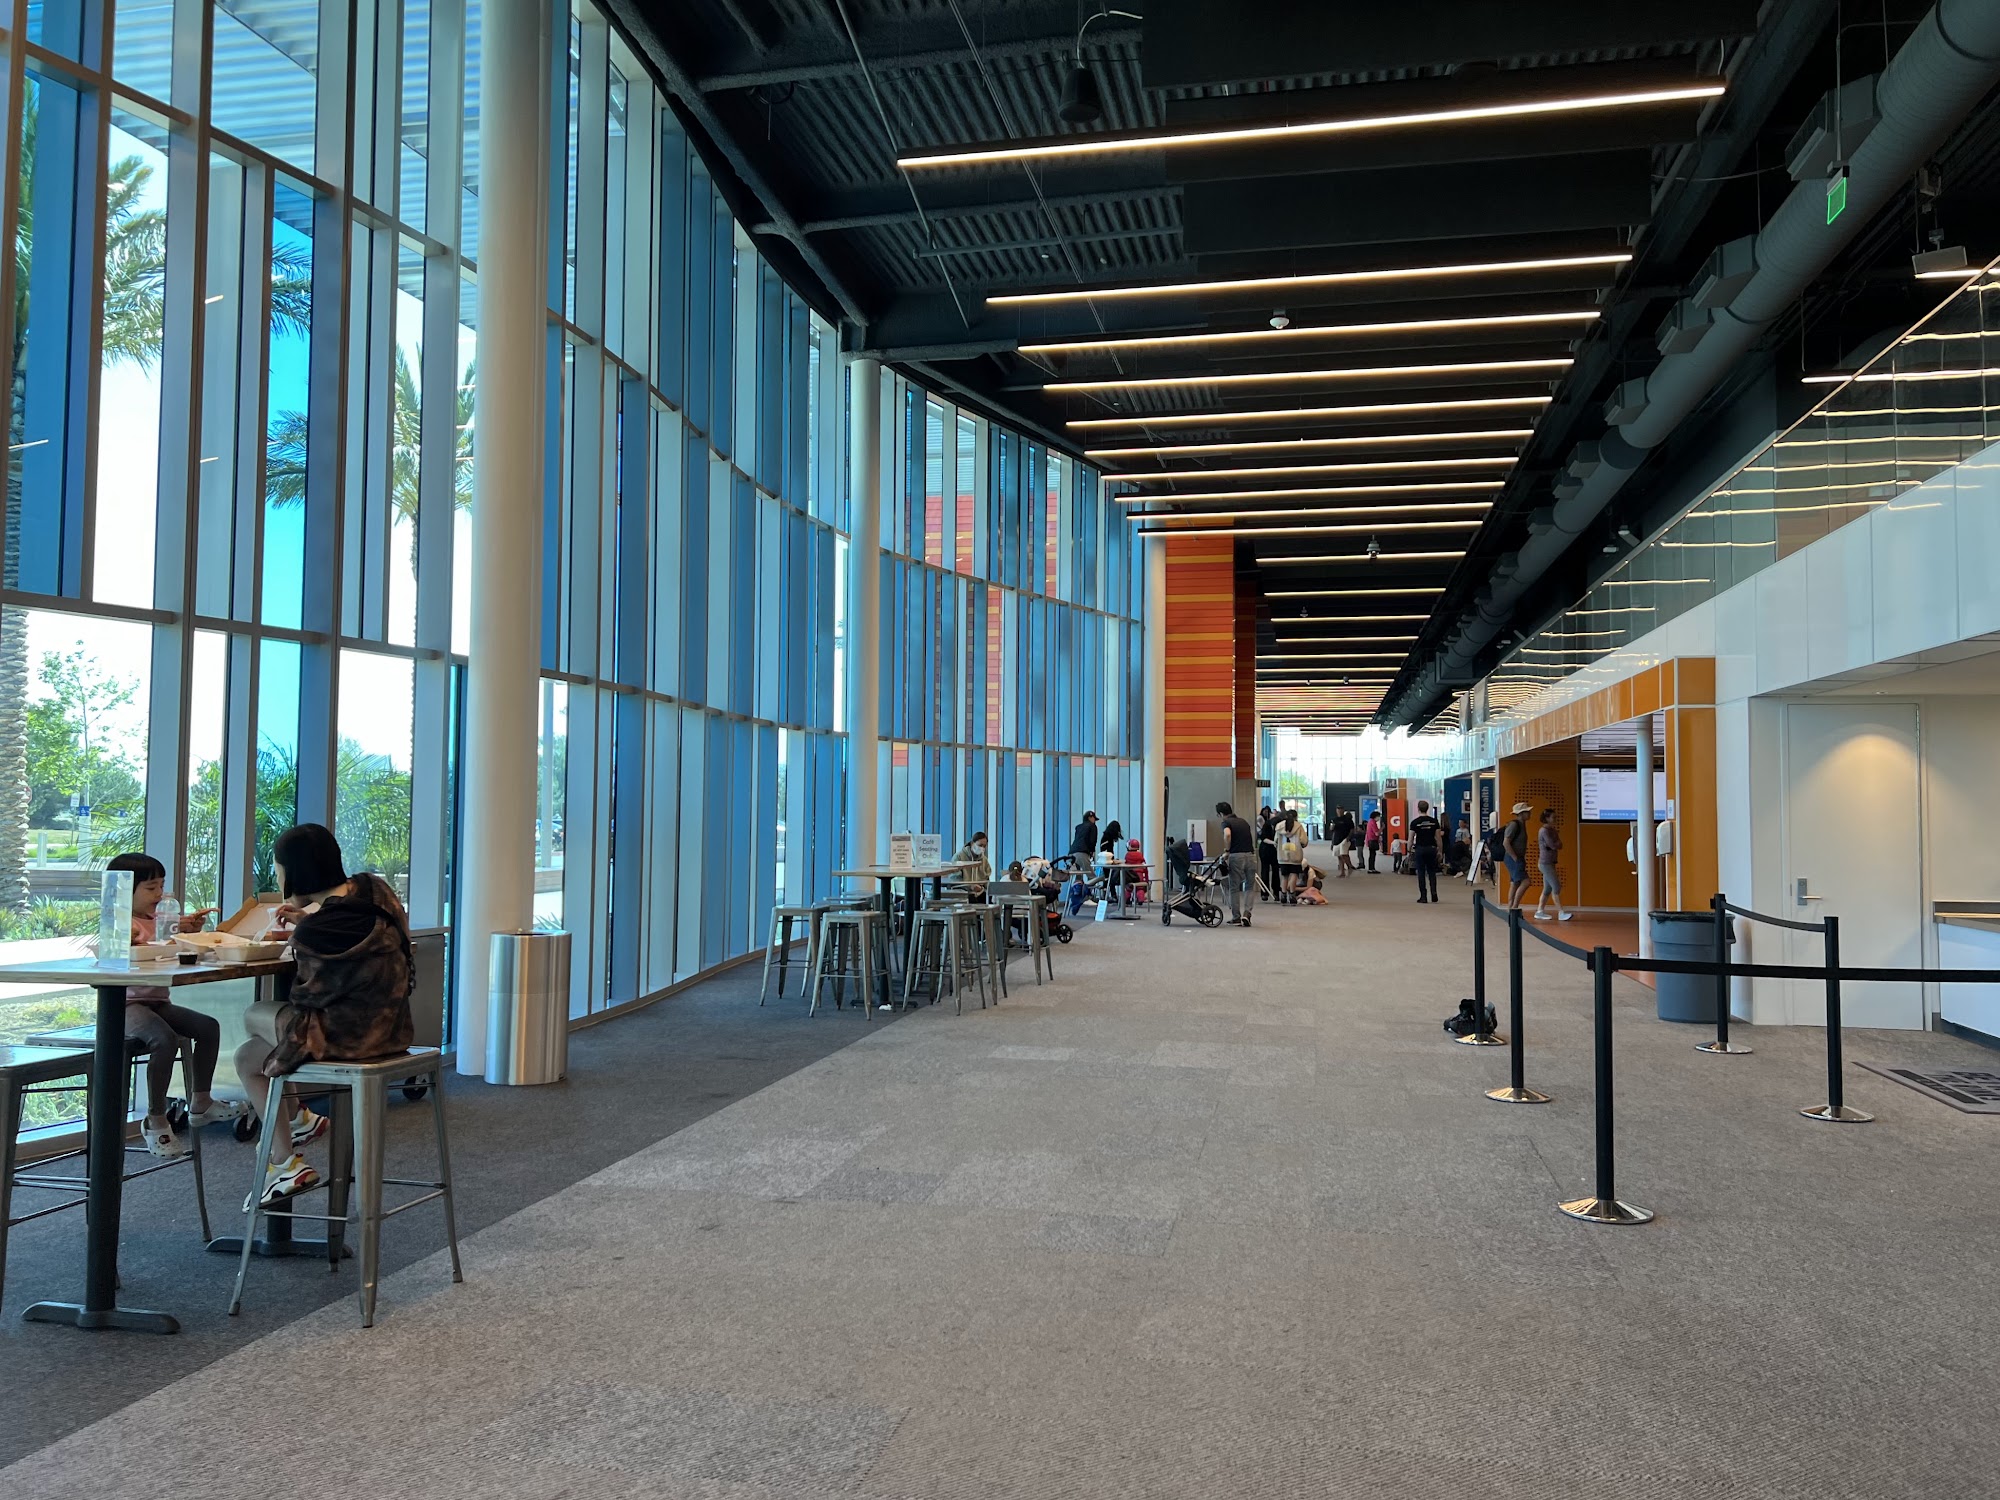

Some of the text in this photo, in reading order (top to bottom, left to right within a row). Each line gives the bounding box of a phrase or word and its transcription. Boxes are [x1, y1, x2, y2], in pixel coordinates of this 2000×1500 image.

[1390, 815, 1401, 827] G
[1481, 786, 1489, 832] UCI Health
